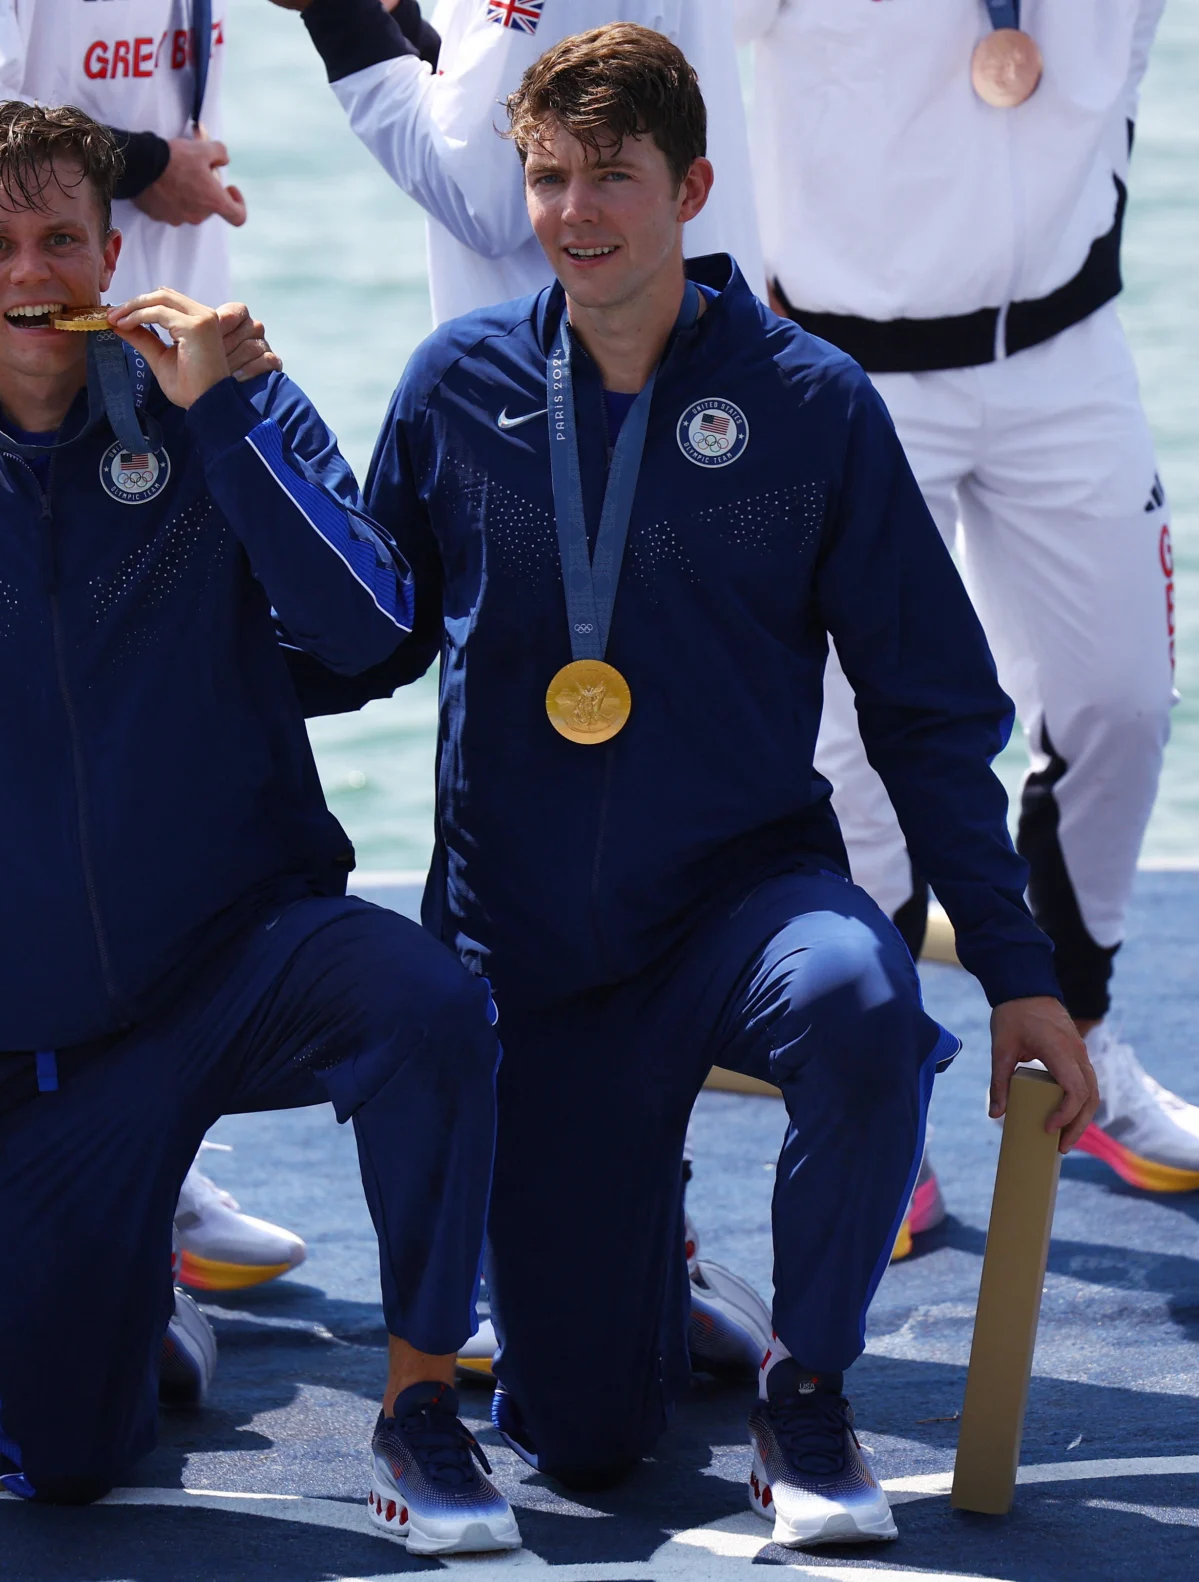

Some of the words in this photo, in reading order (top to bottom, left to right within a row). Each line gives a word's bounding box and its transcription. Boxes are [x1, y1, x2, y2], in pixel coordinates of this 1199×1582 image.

[83, 31, 167, 80] GRE
[552, 349, 563, 390] 2024
[691, 401, 719, 414] UNITED
[720, 403, 743, 424] STATES
[108, 443, 123, 458] UNIT
[683, 441, 710, 464] OLYMPIC
[713, 452, 733, 464] TEAM
[110, 485, 140, 501] OLYMPIC
[143, 482, 161, 498] TEAM
